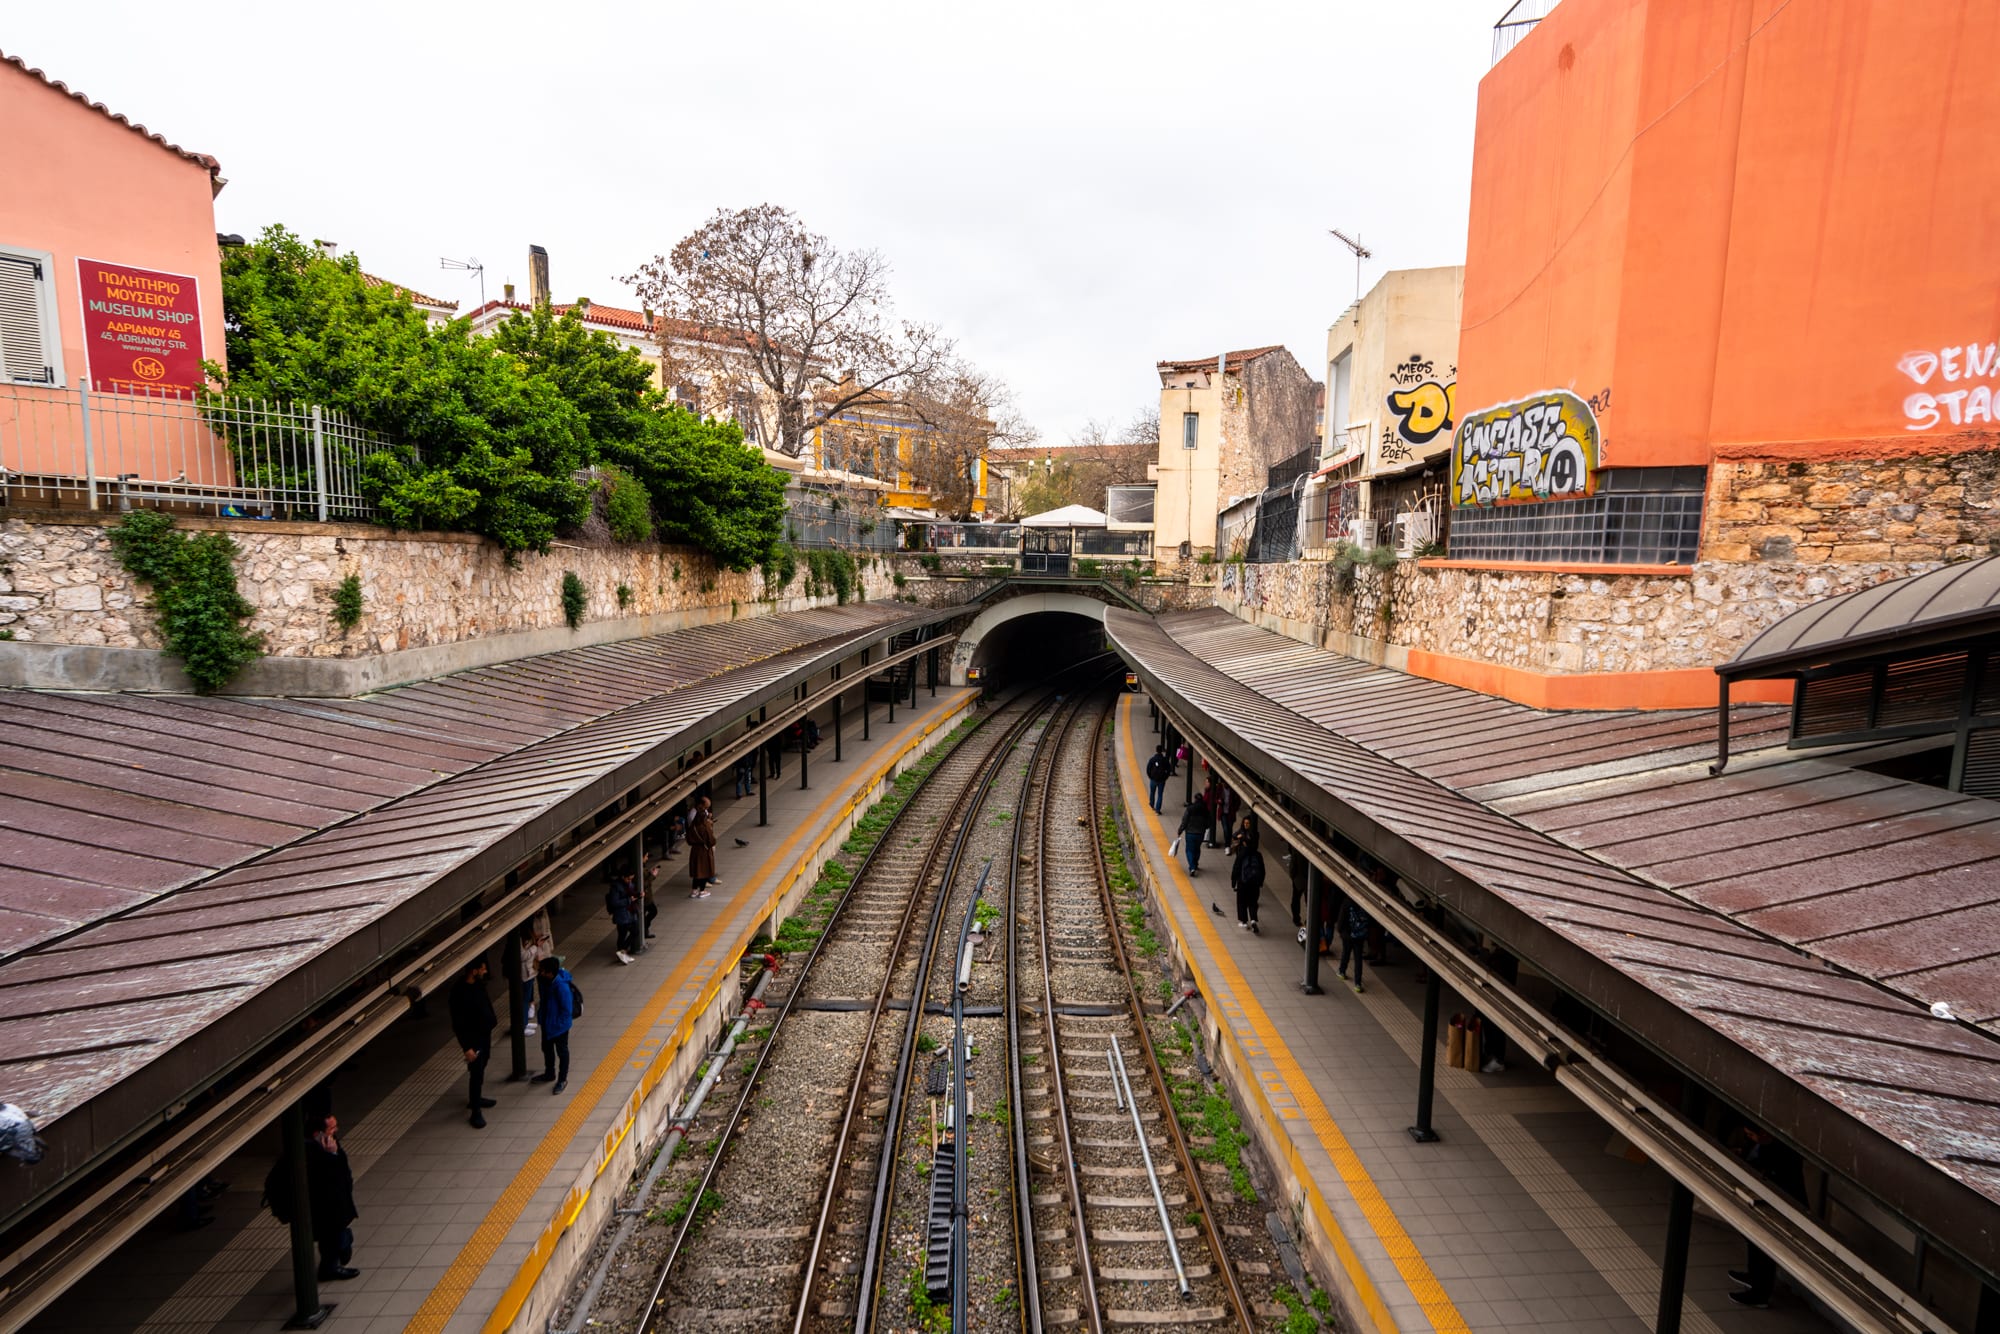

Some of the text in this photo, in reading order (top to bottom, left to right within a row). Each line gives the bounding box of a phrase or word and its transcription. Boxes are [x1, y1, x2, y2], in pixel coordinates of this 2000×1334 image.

[98, 271, 180, 295] ΠΩΛΗΤΗΡΙΟ
[106, 287, 175, 308] ΜΟΥΣΕΙΟΥ
[89, 299, 194, 324] MUSEUM SHOP
[107, 321, 182, 340] ΑΔΡΙΑΝΟΥ 45
[1237, 1029, 1265, 1057] THE
[1261, 1071, 1300, 1119] MIND
